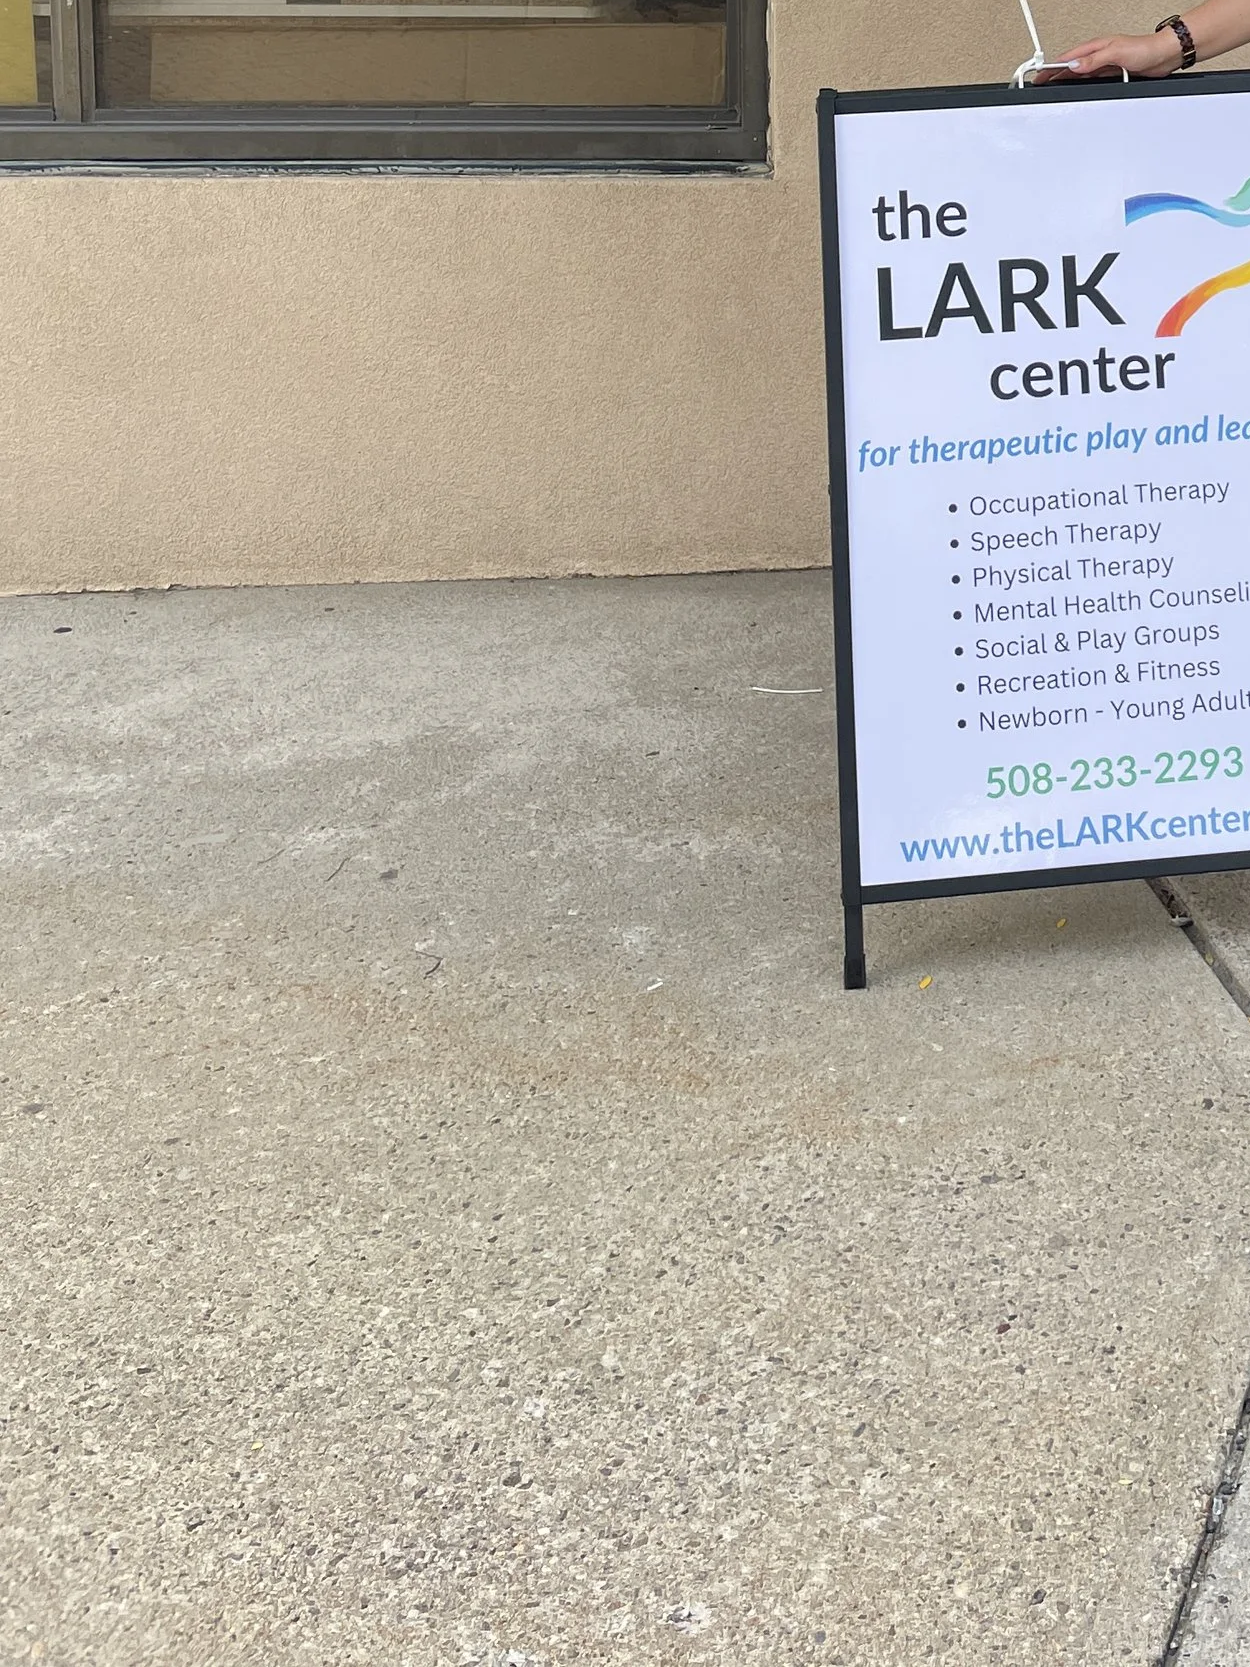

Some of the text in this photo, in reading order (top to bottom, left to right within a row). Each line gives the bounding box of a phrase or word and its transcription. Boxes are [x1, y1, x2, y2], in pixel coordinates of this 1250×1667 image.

[872, 190, 968, 241] the
[877, 252, 1126, 341] LARK
[990, 347, 1175, 400] center
[858, 439, 902, 472] for
[909, 426, 1078, 465] therapeutic
[1087, 422, 1147, 456] play
[1154, 415, 1209, 445] and
[969, 479, 1230, 519] Occupational Therapy
[970, 520, 1162, 556] Speech Therapy
[972, 554, 1174, 591] Physical Therapy
[975, 597, 1057, 624] Mental
[1064, 590, 1142, 616] Health
[975, 622, 1220, 659] Social & Play Groups
[977, 658, 1221, 696] Recreation & Fitness
[979, 703, 1088, 733] Newborn
[1110, 696, 1185, 722] Young
[986, 746, 1244, 800] 508-233-2293
